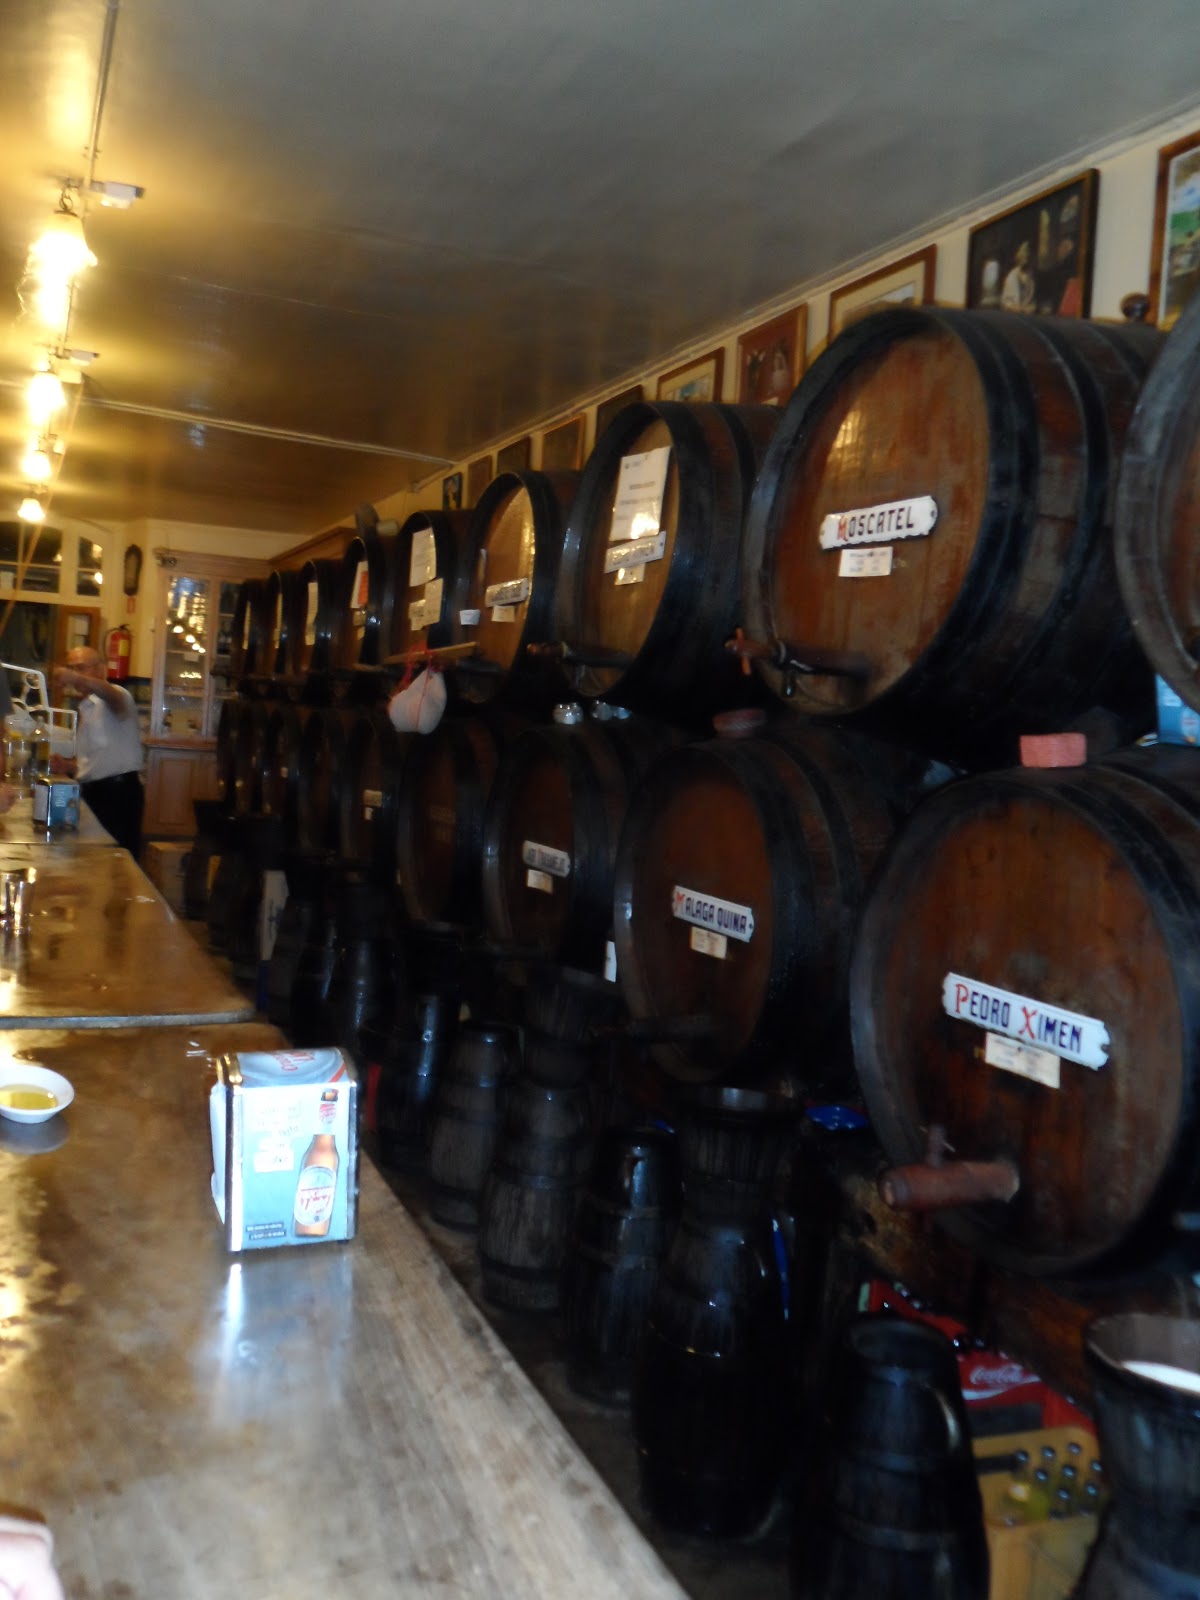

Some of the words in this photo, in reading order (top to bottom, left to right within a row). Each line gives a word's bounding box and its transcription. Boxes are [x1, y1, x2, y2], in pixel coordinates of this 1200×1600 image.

[836, 506, 914, 542] MOSCATEL
[675, 893, 715, 923] MALAGA
[717, 907, 747, 934] QUINA
[955, 983, 1011, 1028] PEDRO
[1018, 1006, 1083, 1054] XIMEN
